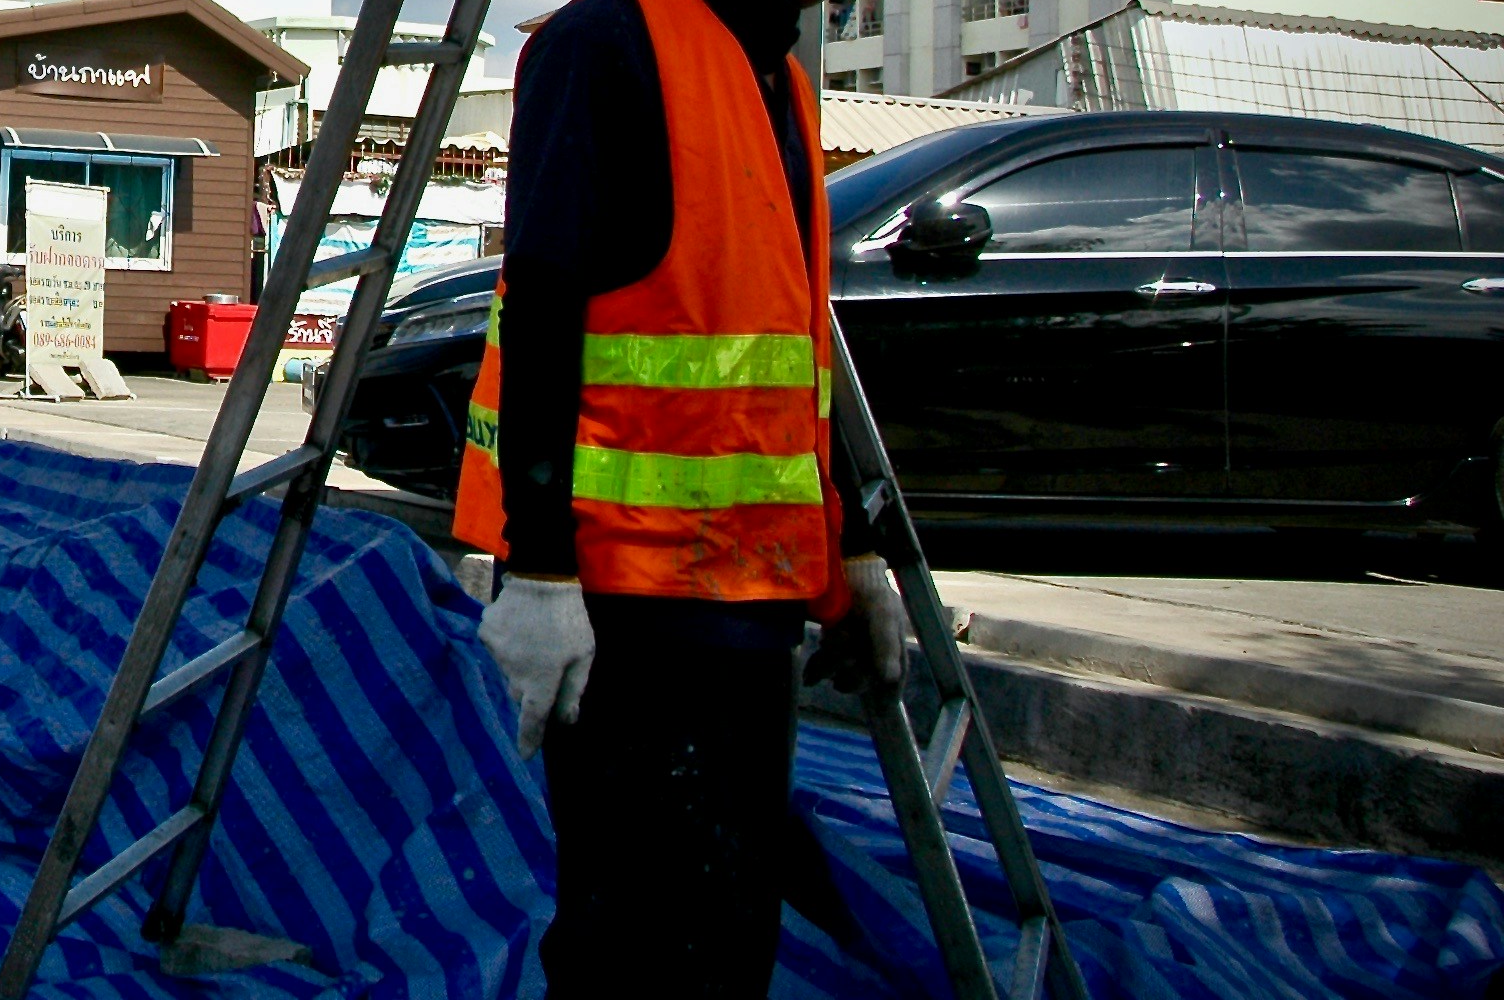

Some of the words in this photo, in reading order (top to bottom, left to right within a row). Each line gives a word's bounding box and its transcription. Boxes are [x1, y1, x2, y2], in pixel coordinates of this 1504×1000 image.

[27, 53, 151, 88] บ้านกาแฟ
[51, 224, 82, 243] บริการ
